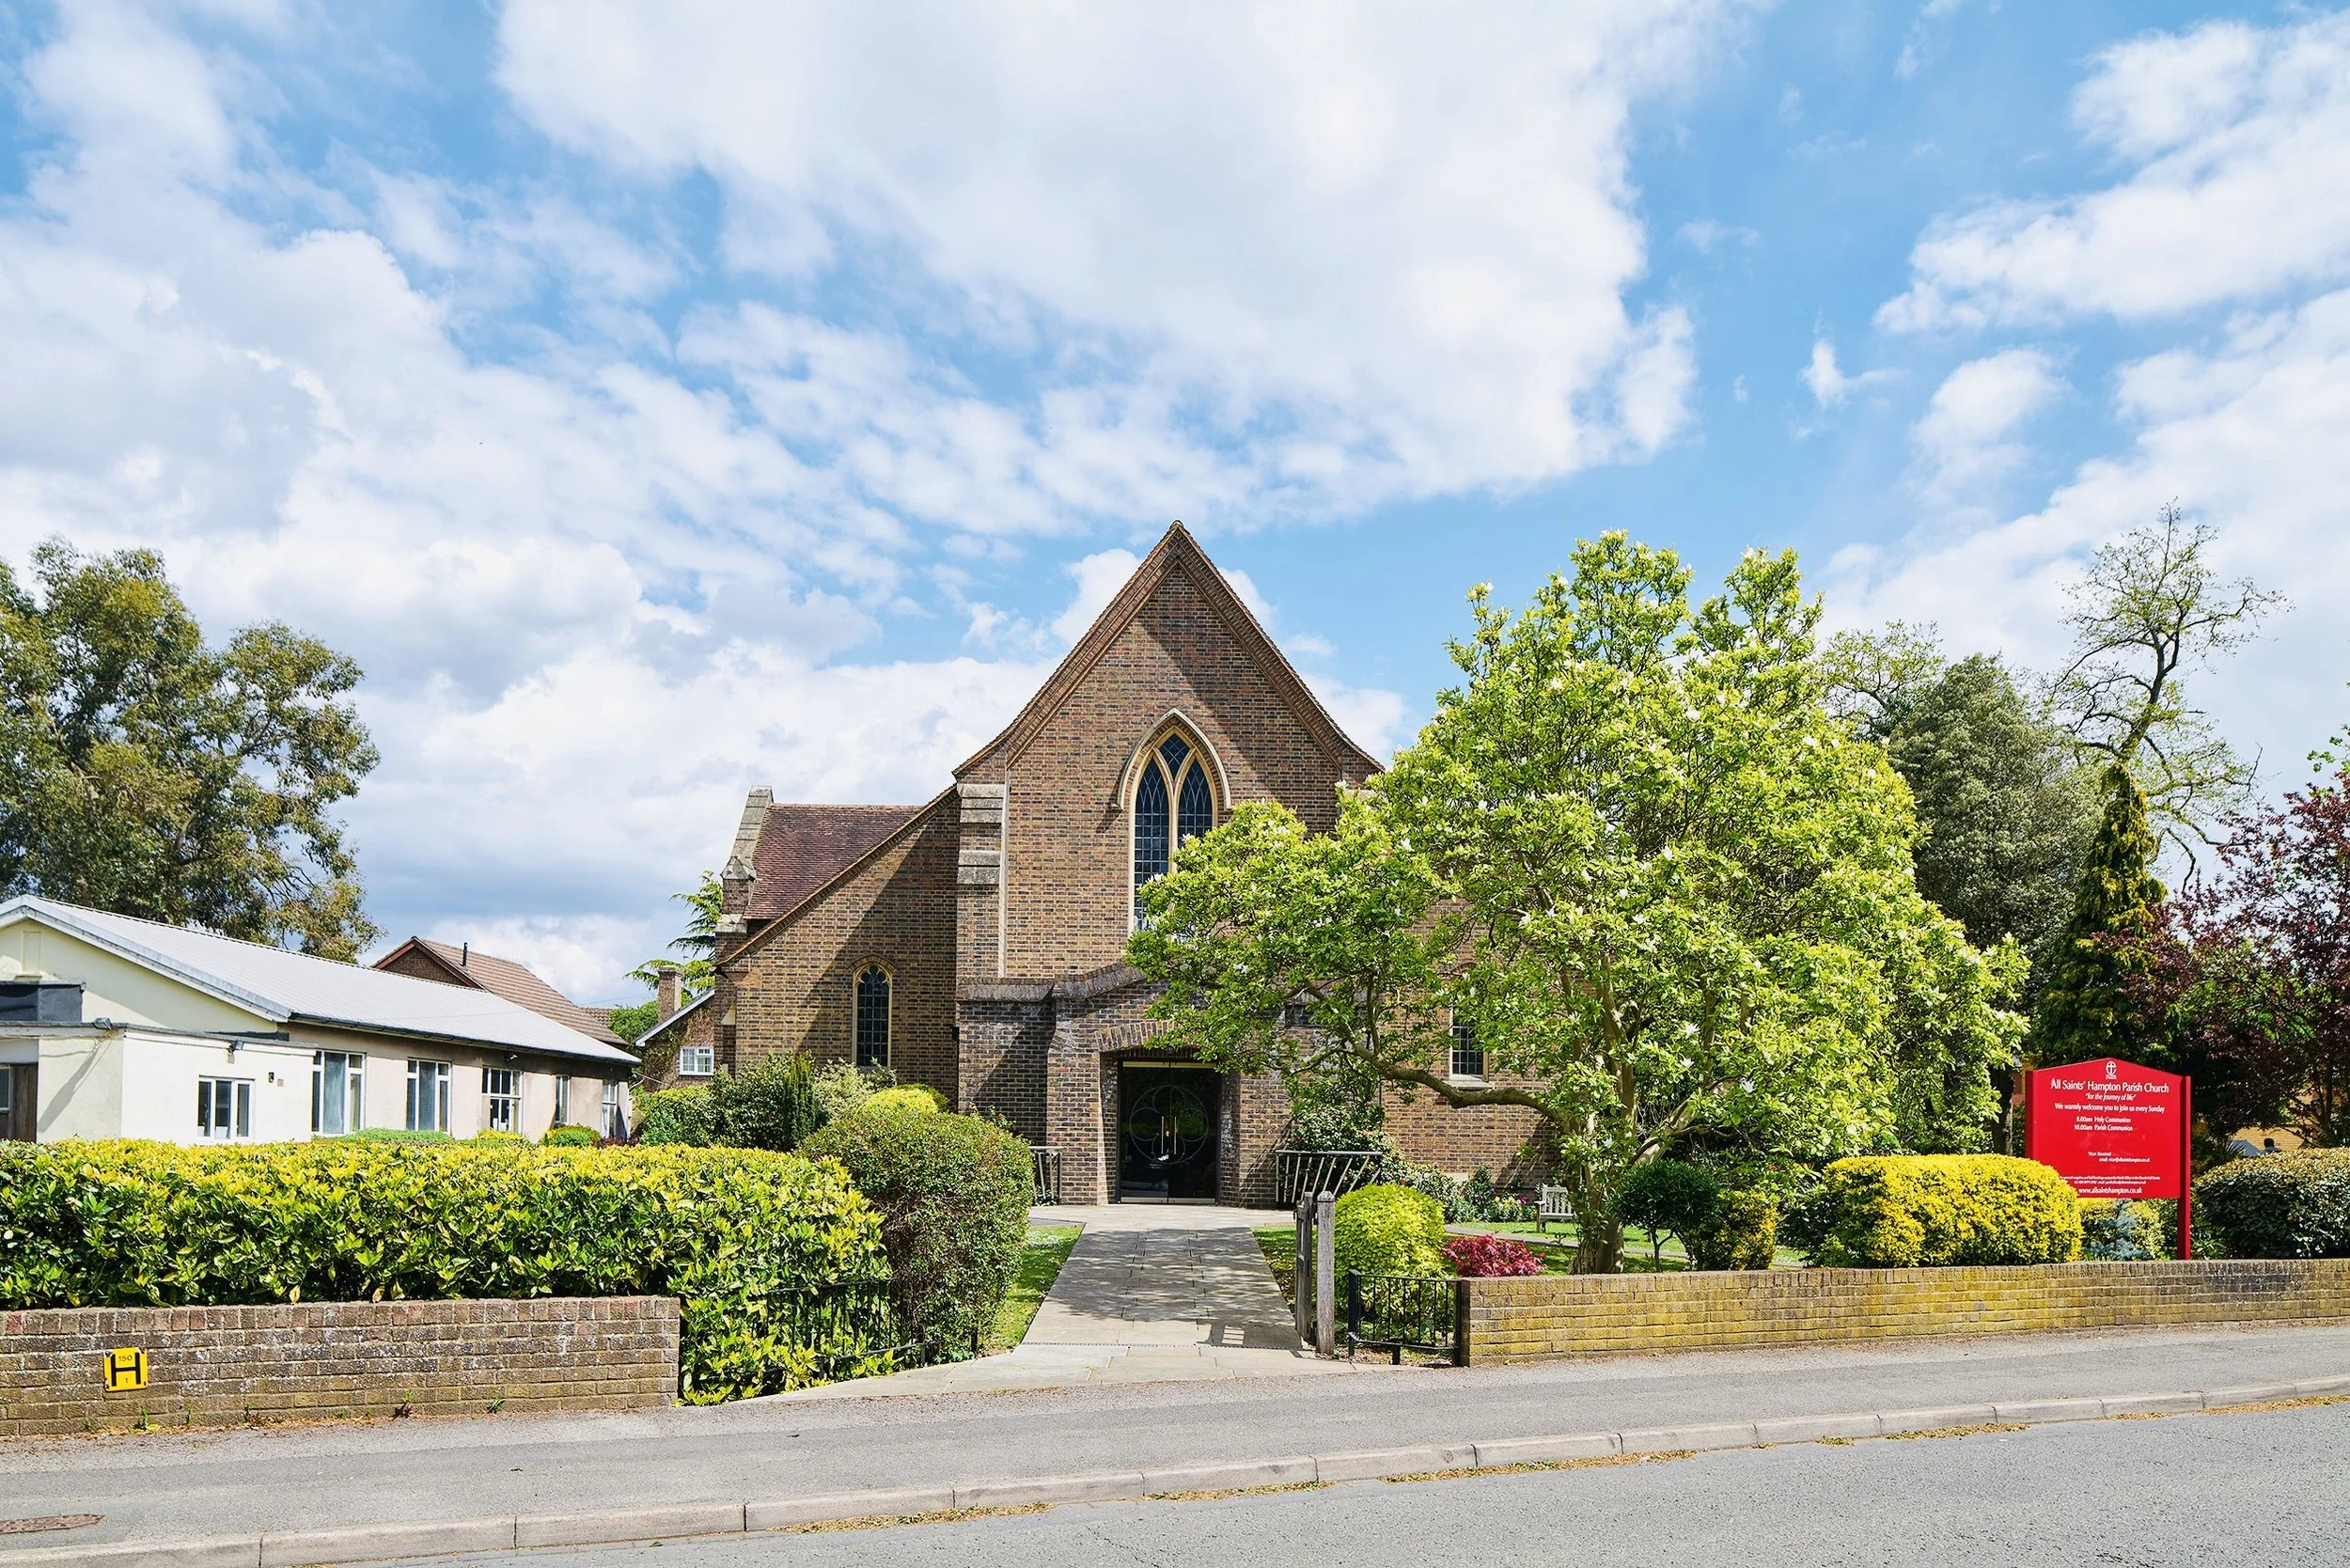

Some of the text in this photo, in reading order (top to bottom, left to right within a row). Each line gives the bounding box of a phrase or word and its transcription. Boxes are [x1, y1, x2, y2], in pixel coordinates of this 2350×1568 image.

[2051, 1077, 2061, 1090] All
[2087, 1080, 2121, 1093] Hampton
[2123, 1082, 2142, 1092] Parish
[2144, 1083, 2170, 1093] Church
[2103, 1093, 2121, 1102] journey
[2064, 1103, 2081, 1111] warmly
[2119, 1105, 2129, 1113] join
[2148, 1105, 2165, 1114] Sunday
[2078, 1186, 2143, 1195] www.allsaintshampton.co.uk
[110, 1352, 141, 1387] H
